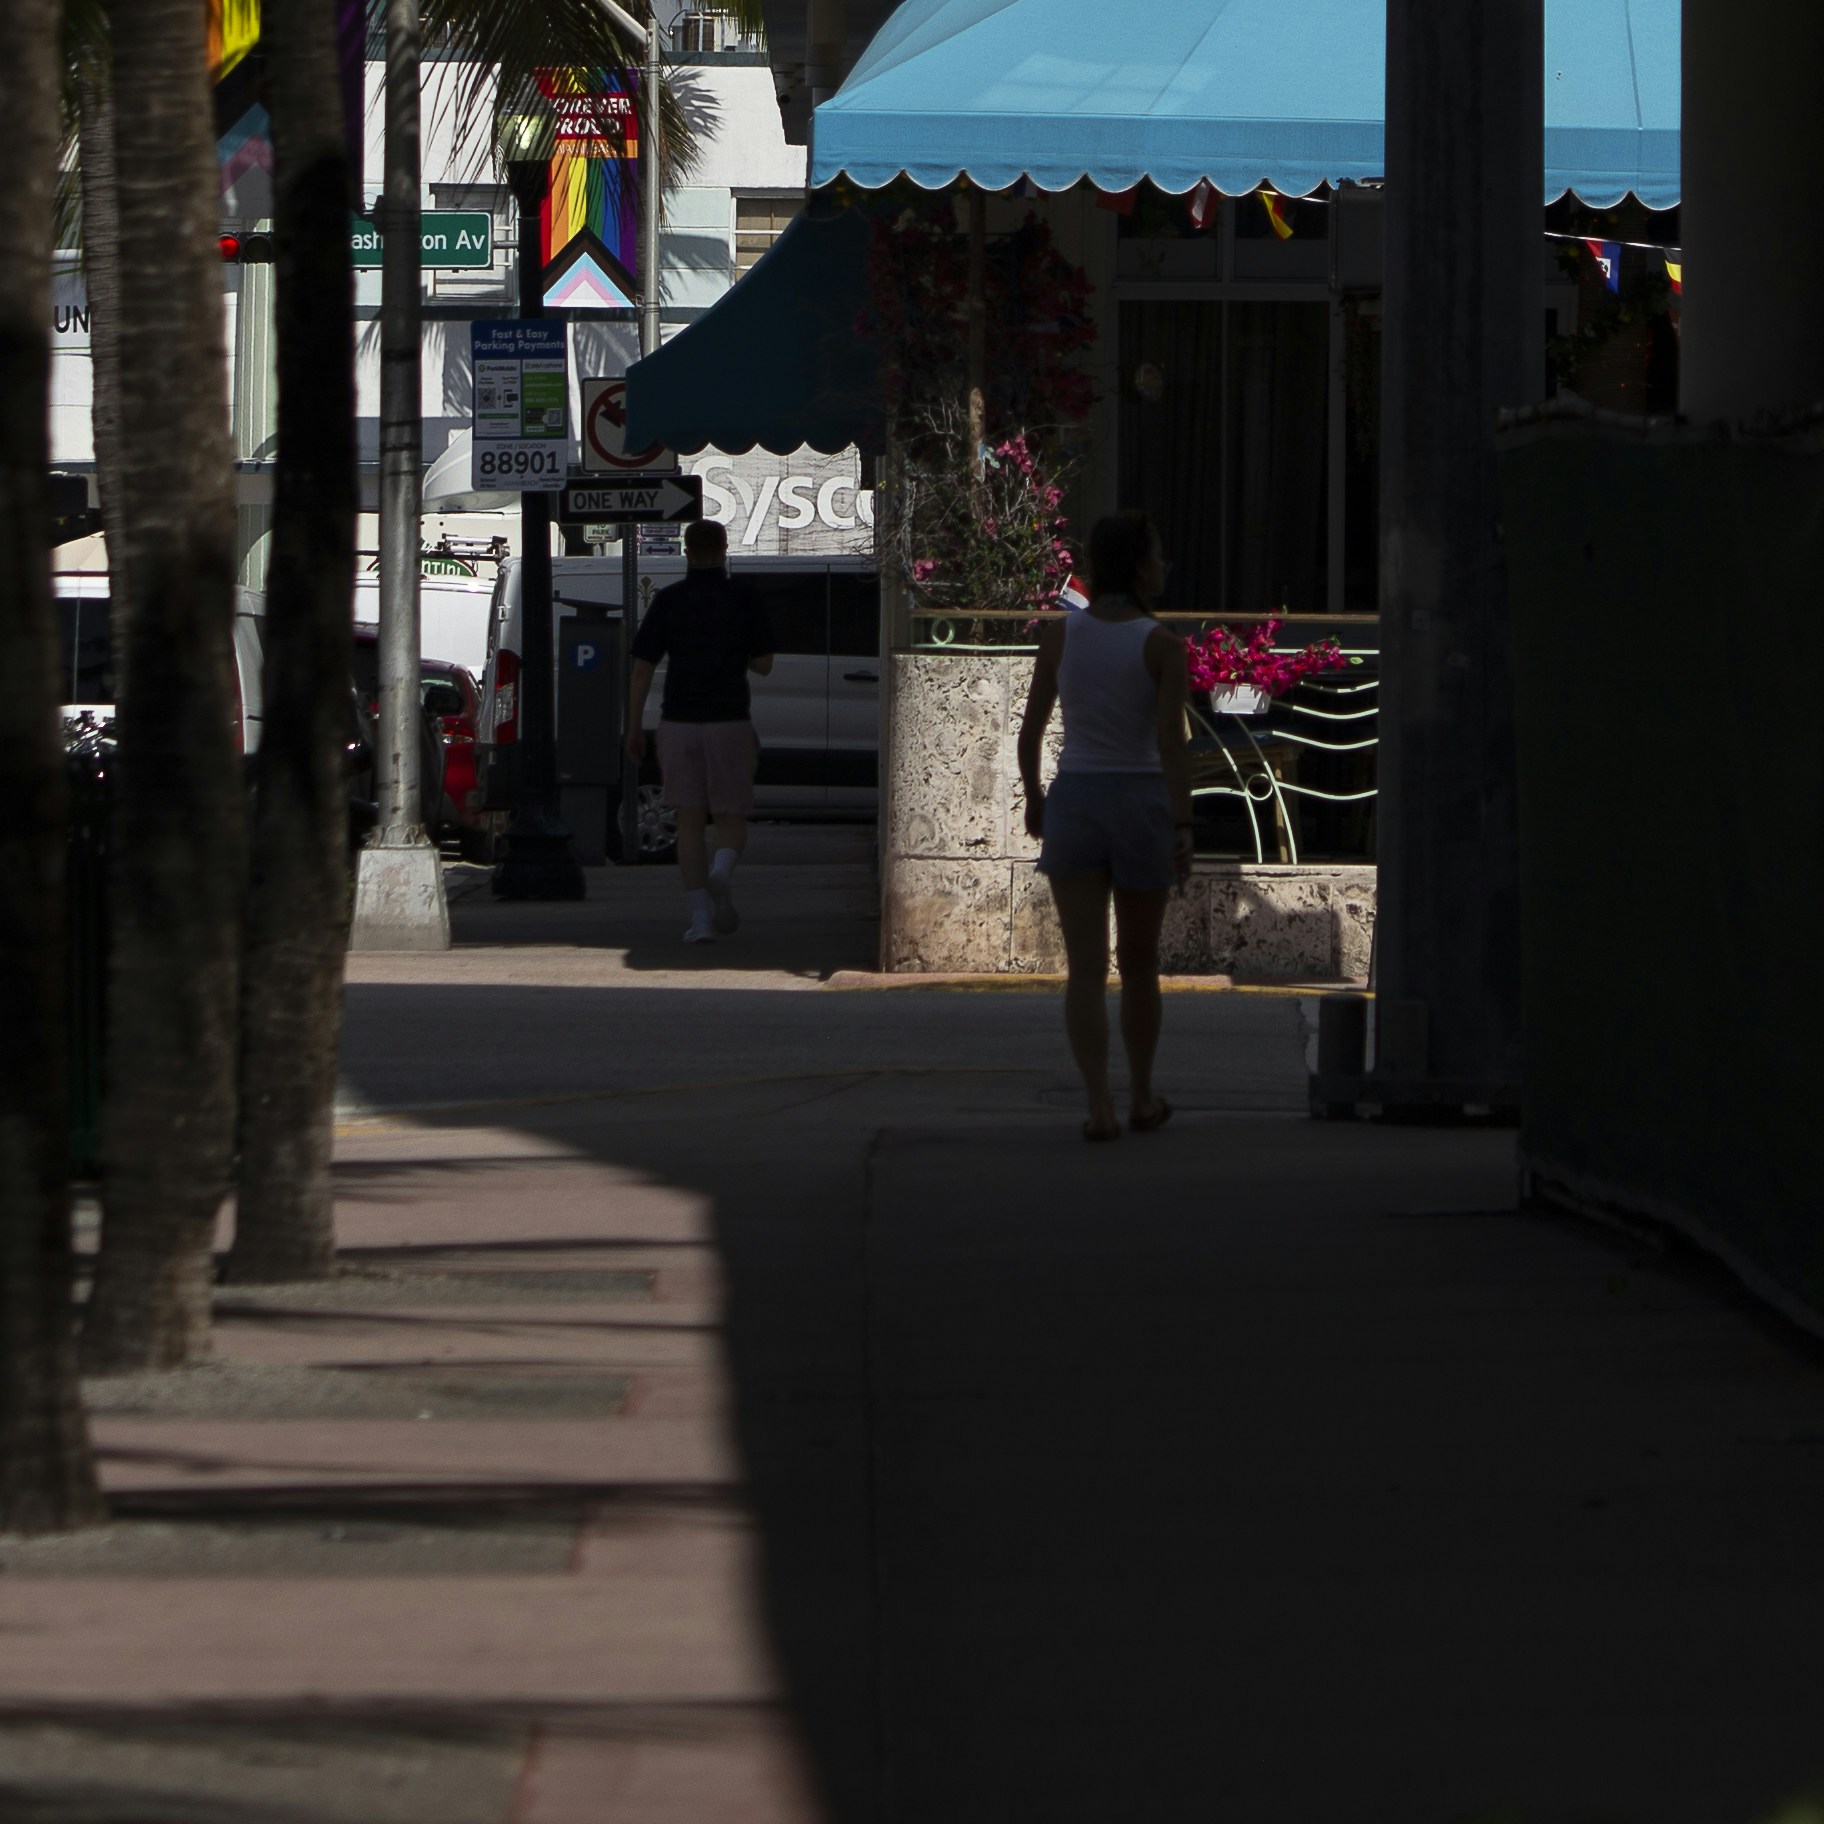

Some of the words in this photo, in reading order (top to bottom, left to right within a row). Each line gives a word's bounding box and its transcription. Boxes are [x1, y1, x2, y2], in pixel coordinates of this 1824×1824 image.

[455, 229, 485, 250] Av
[492, 329, 513, 339] Fast
[515, 329, 523, 339] &
[526, 329, 549, 340] Easy
[474, 340, 515, 352] Parking
[518, 340, 565, 352] Payments
[480, 450, 560, 475] 88901
[574, 491, 612, 510] ONE
[619, 491, 659, 509] WAY
[577, 645, 595, 666] P
